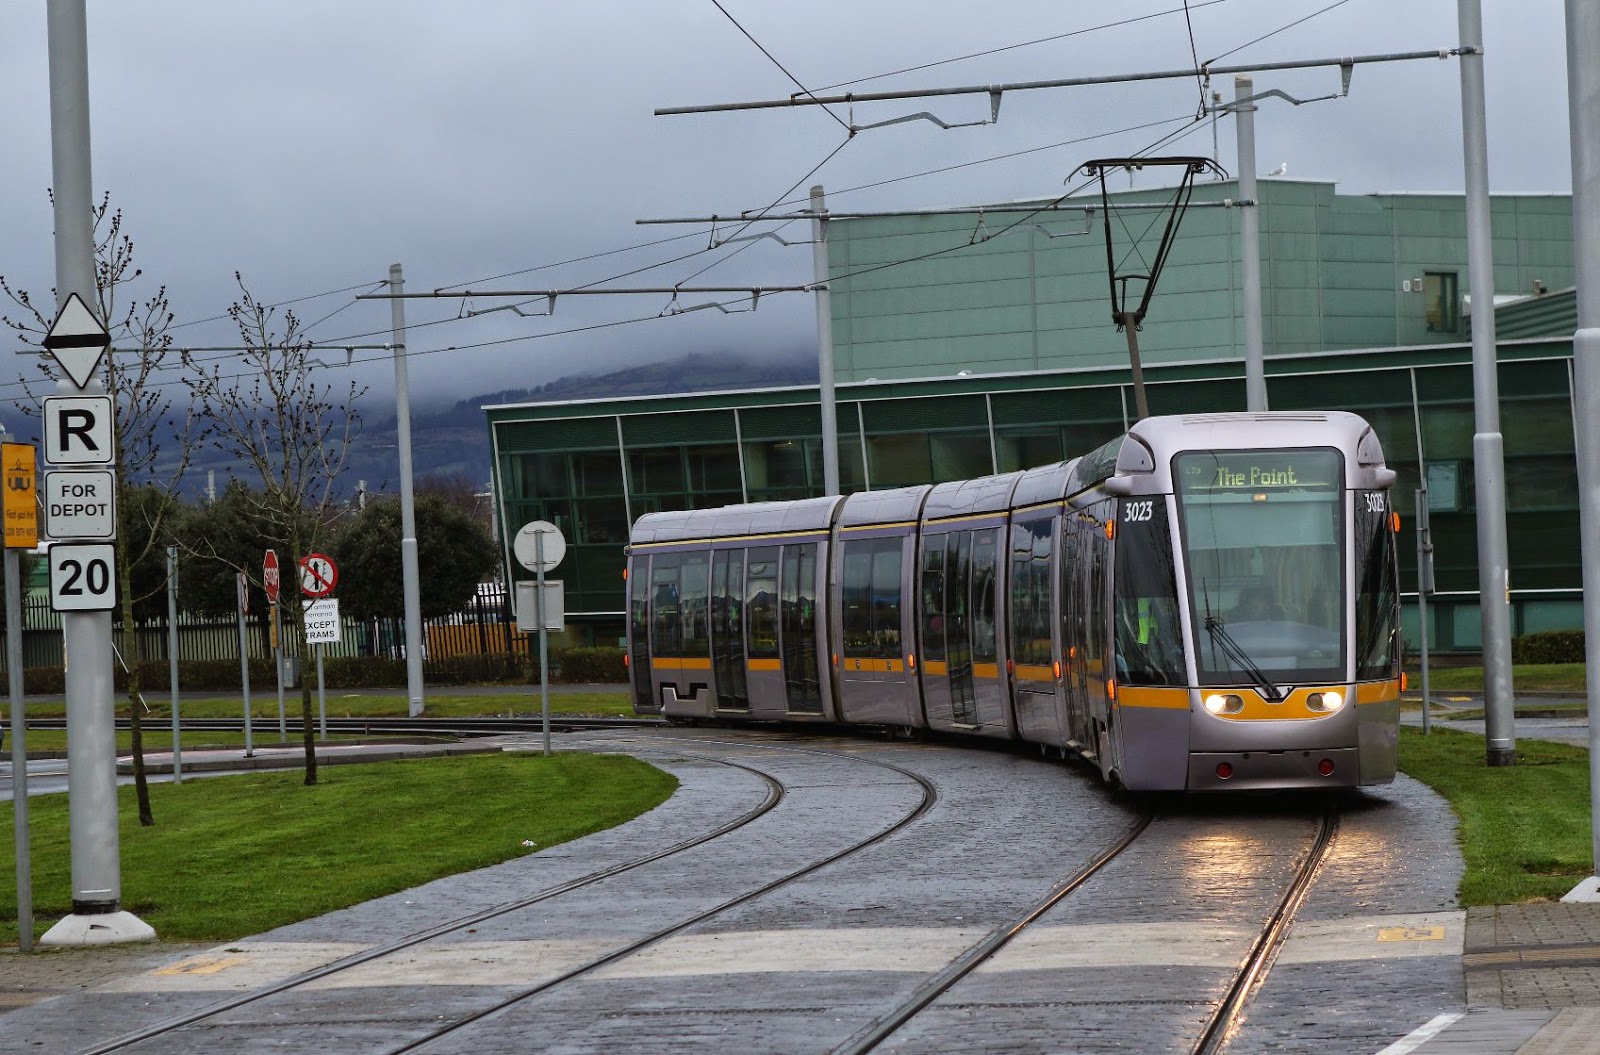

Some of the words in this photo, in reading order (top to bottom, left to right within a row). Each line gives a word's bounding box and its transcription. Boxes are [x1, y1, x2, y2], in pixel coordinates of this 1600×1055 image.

[58, 408, 99, 451] R
[1218, 467, 1246, 486] The
[1251, 465, 1297, 485] Point
[61, 485, 96, 497] FOR
[51, 504, 107, 517] DEPOT
[1124, 501, 1153, 522] 3023
[1364, 493, 1384, 512] 3023
[59, 559, 109, 595] 20
[265, 567, 278, 586] STOP
[304, 620, 336, 630] EXCEPT
[306, 630, 335, 639] TRAMS
